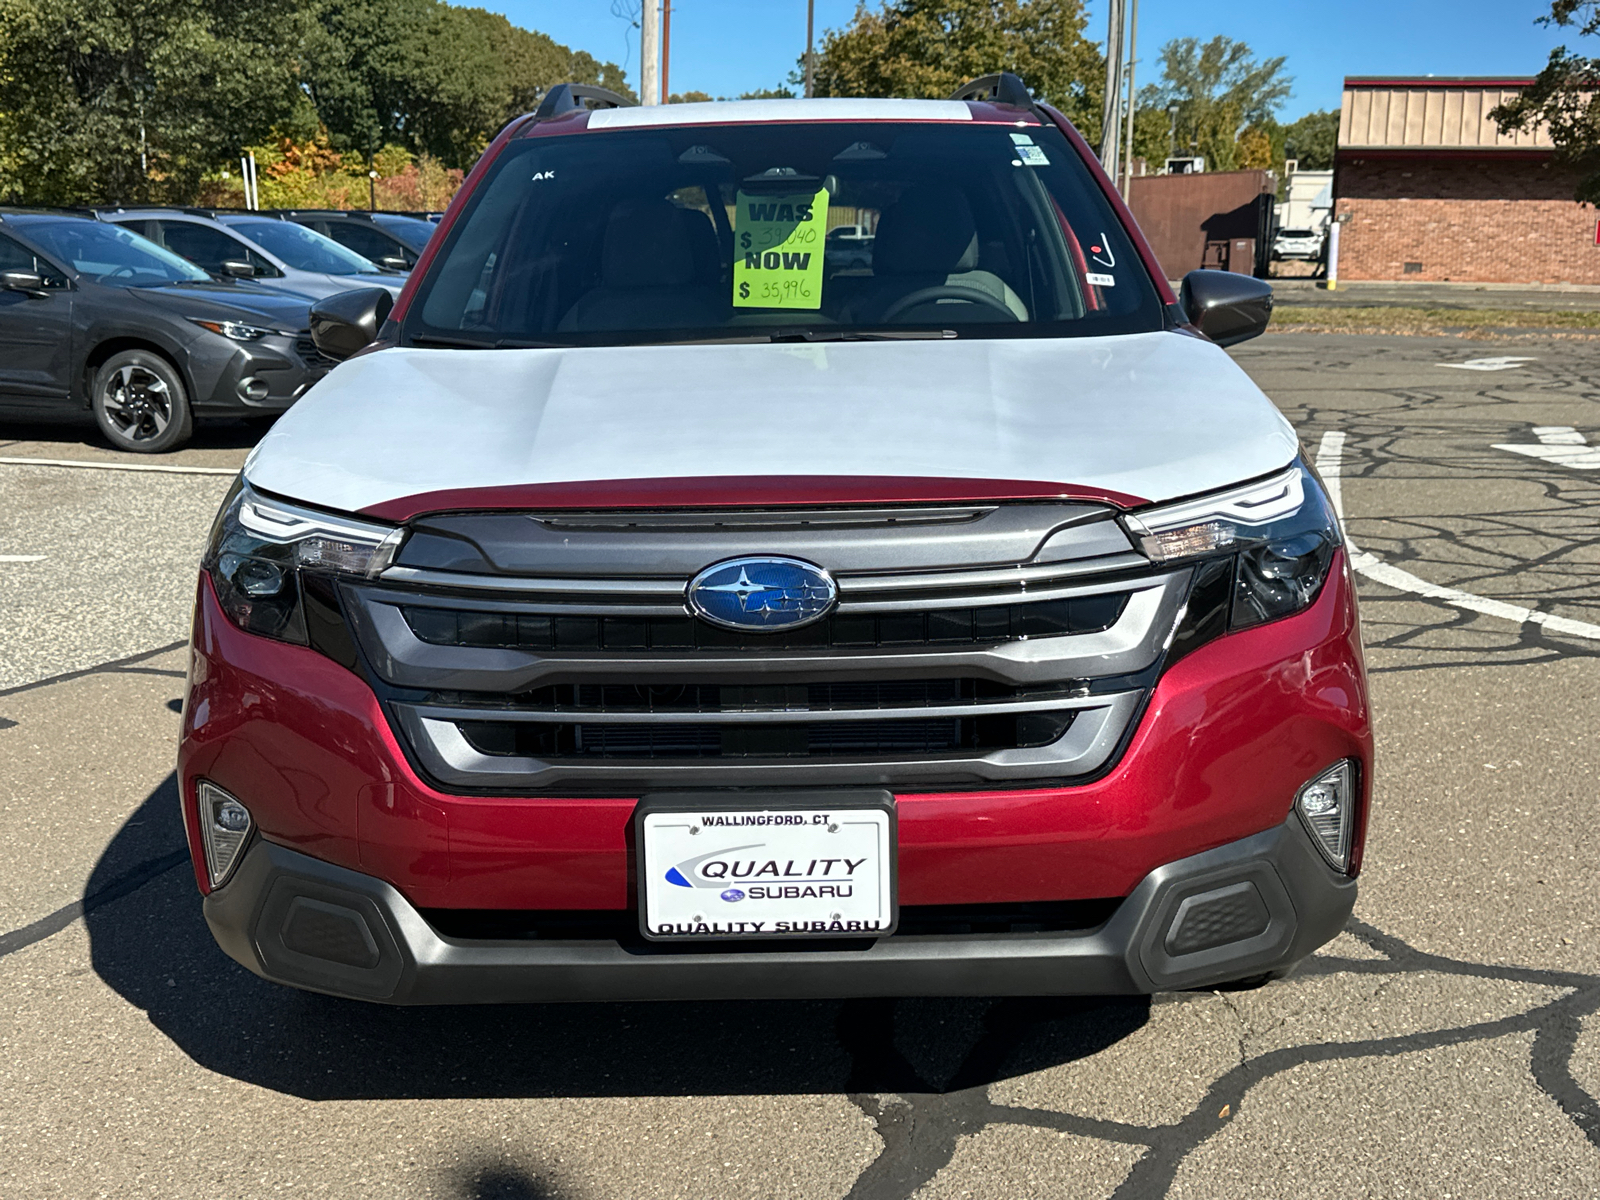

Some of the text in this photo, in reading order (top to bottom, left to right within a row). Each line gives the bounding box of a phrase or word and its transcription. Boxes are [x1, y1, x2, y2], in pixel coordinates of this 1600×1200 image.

[532, 170, 555, 181] AK
[748, 203, 814, 222] WAS
[740, 230, 752, 250] $
[745, 252, 812, 270] NOW
[739, 279, 811, 304] $ 35,996
[702, 815, 830, 826] WALLINGFORD, CT
[701, 858, 867, 879] QUALITY
[748, 885, 853, 899] SUBARU
[658, 920, 880, 935] QUALITY SUBARU
